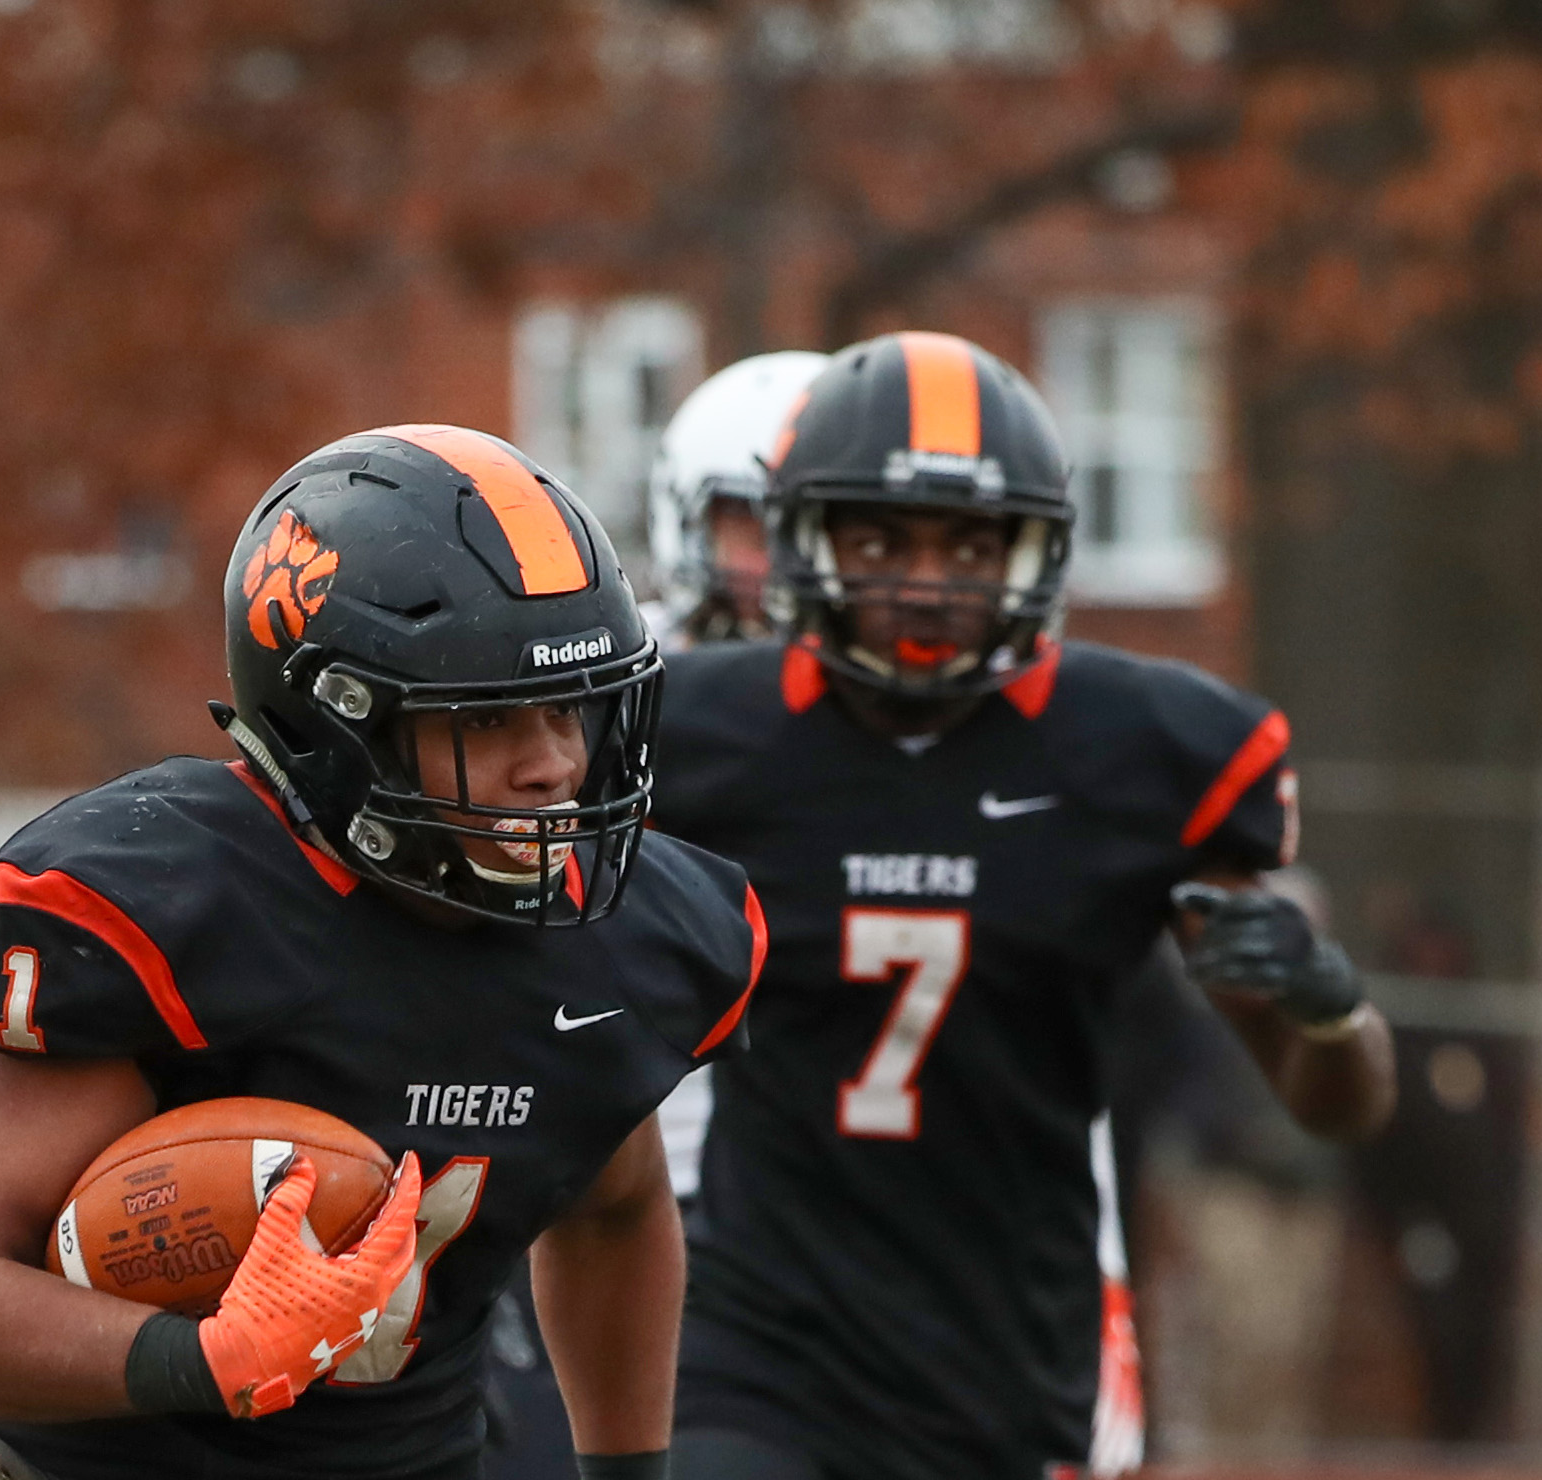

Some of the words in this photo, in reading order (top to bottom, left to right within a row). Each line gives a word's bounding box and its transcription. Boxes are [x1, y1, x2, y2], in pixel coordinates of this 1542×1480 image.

[532, 632, 612, 667] Riddell
[839, 853, 979, 897] TIGERS
[836, 904, 972, 1141] 7
[405, 1084, 535, 1127] TIGERS
[122, 1182, 178, 1216] NCAA
[105, 1231, 239, 1288] Wilson
